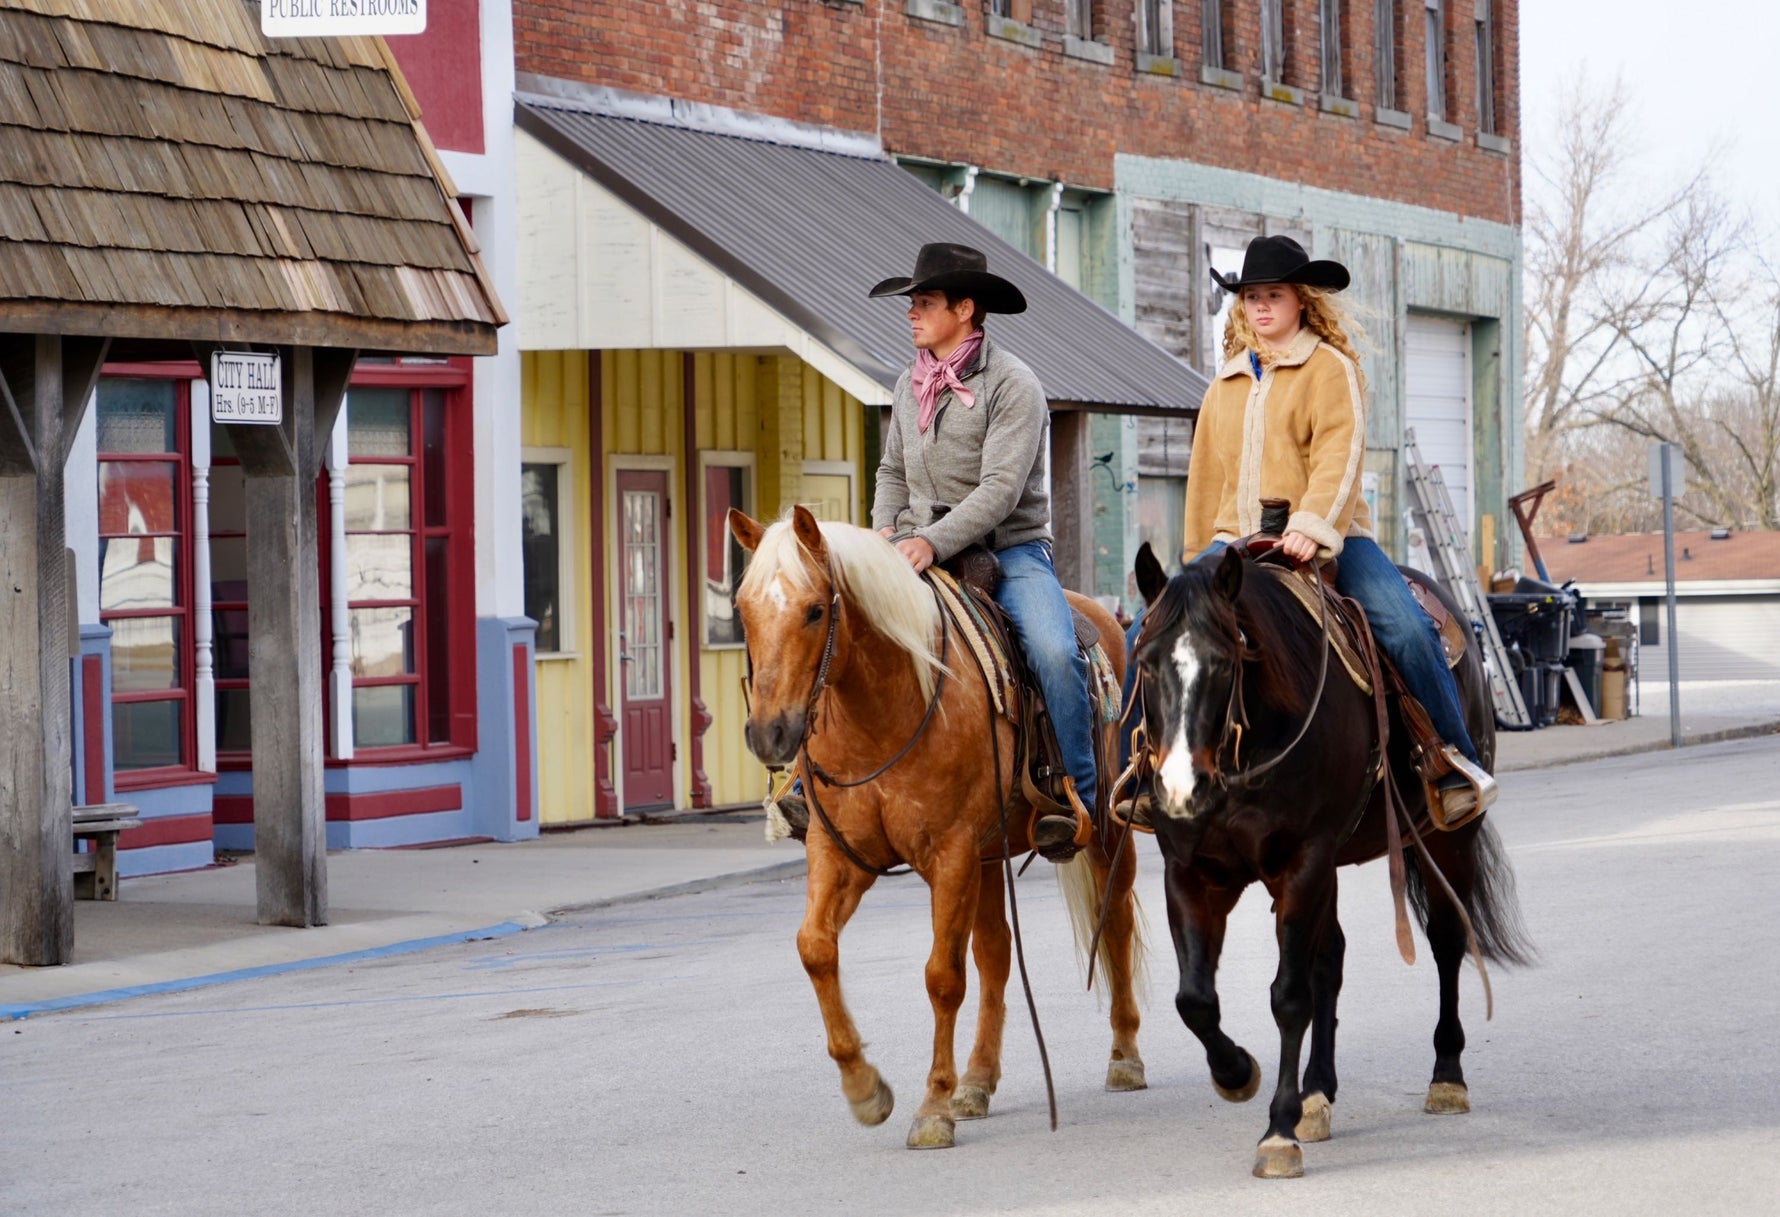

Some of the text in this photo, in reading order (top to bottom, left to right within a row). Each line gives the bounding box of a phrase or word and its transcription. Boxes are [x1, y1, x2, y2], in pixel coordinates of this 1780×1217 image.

[269, 0, 418, 18] PUBLIC RESTROOMS
[217, 361, 277, 391] CITY HALL
[216, 393, 279, 417] Hrs. (9-5 M-F)
